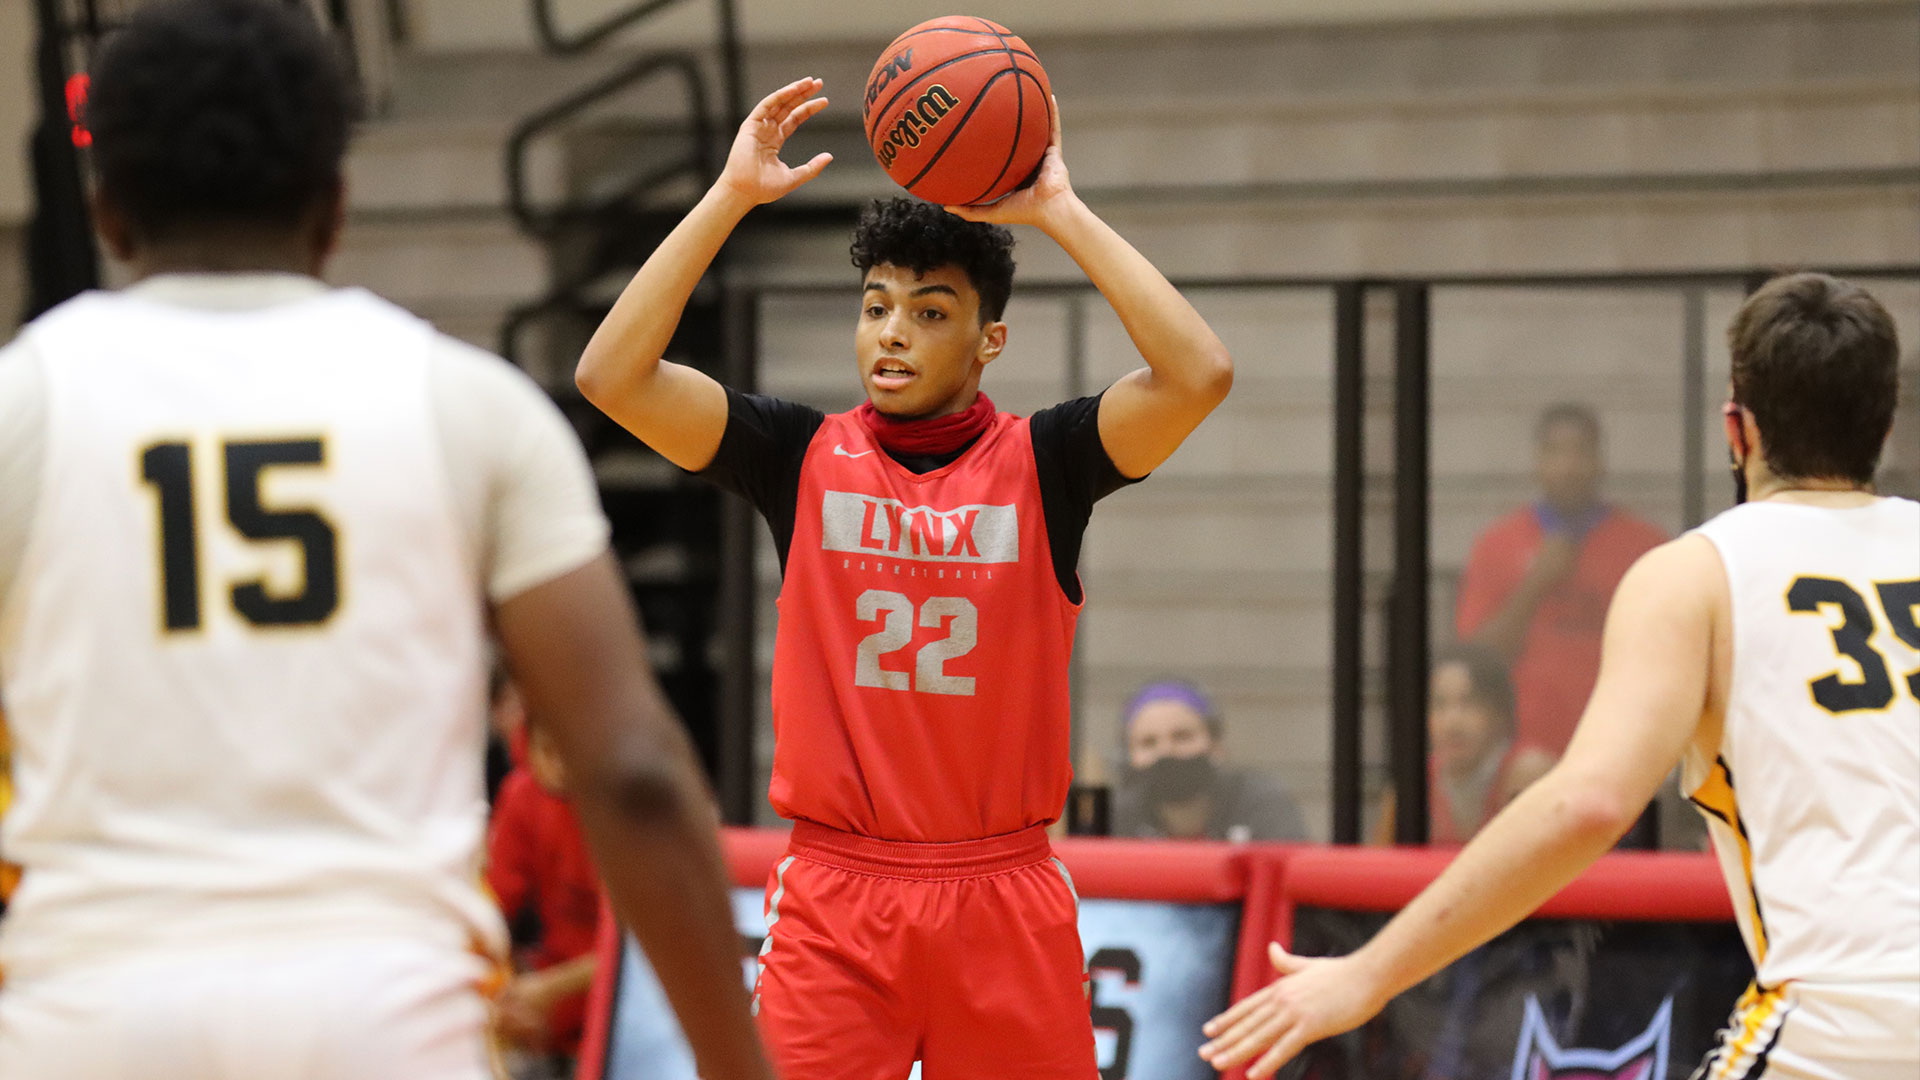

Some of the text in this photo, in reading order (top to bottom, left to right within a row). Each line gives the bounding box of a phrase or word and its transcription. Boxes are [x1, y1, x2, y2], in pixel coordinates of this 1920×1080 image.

[878, 84, 960, 169] Wilson
[139, 437, 340, 631] 15
[843, 559, 992, 580] BASKETBALL
[860, 500, 982, 557] LYNX
[855, 589, 978, 696] 22
